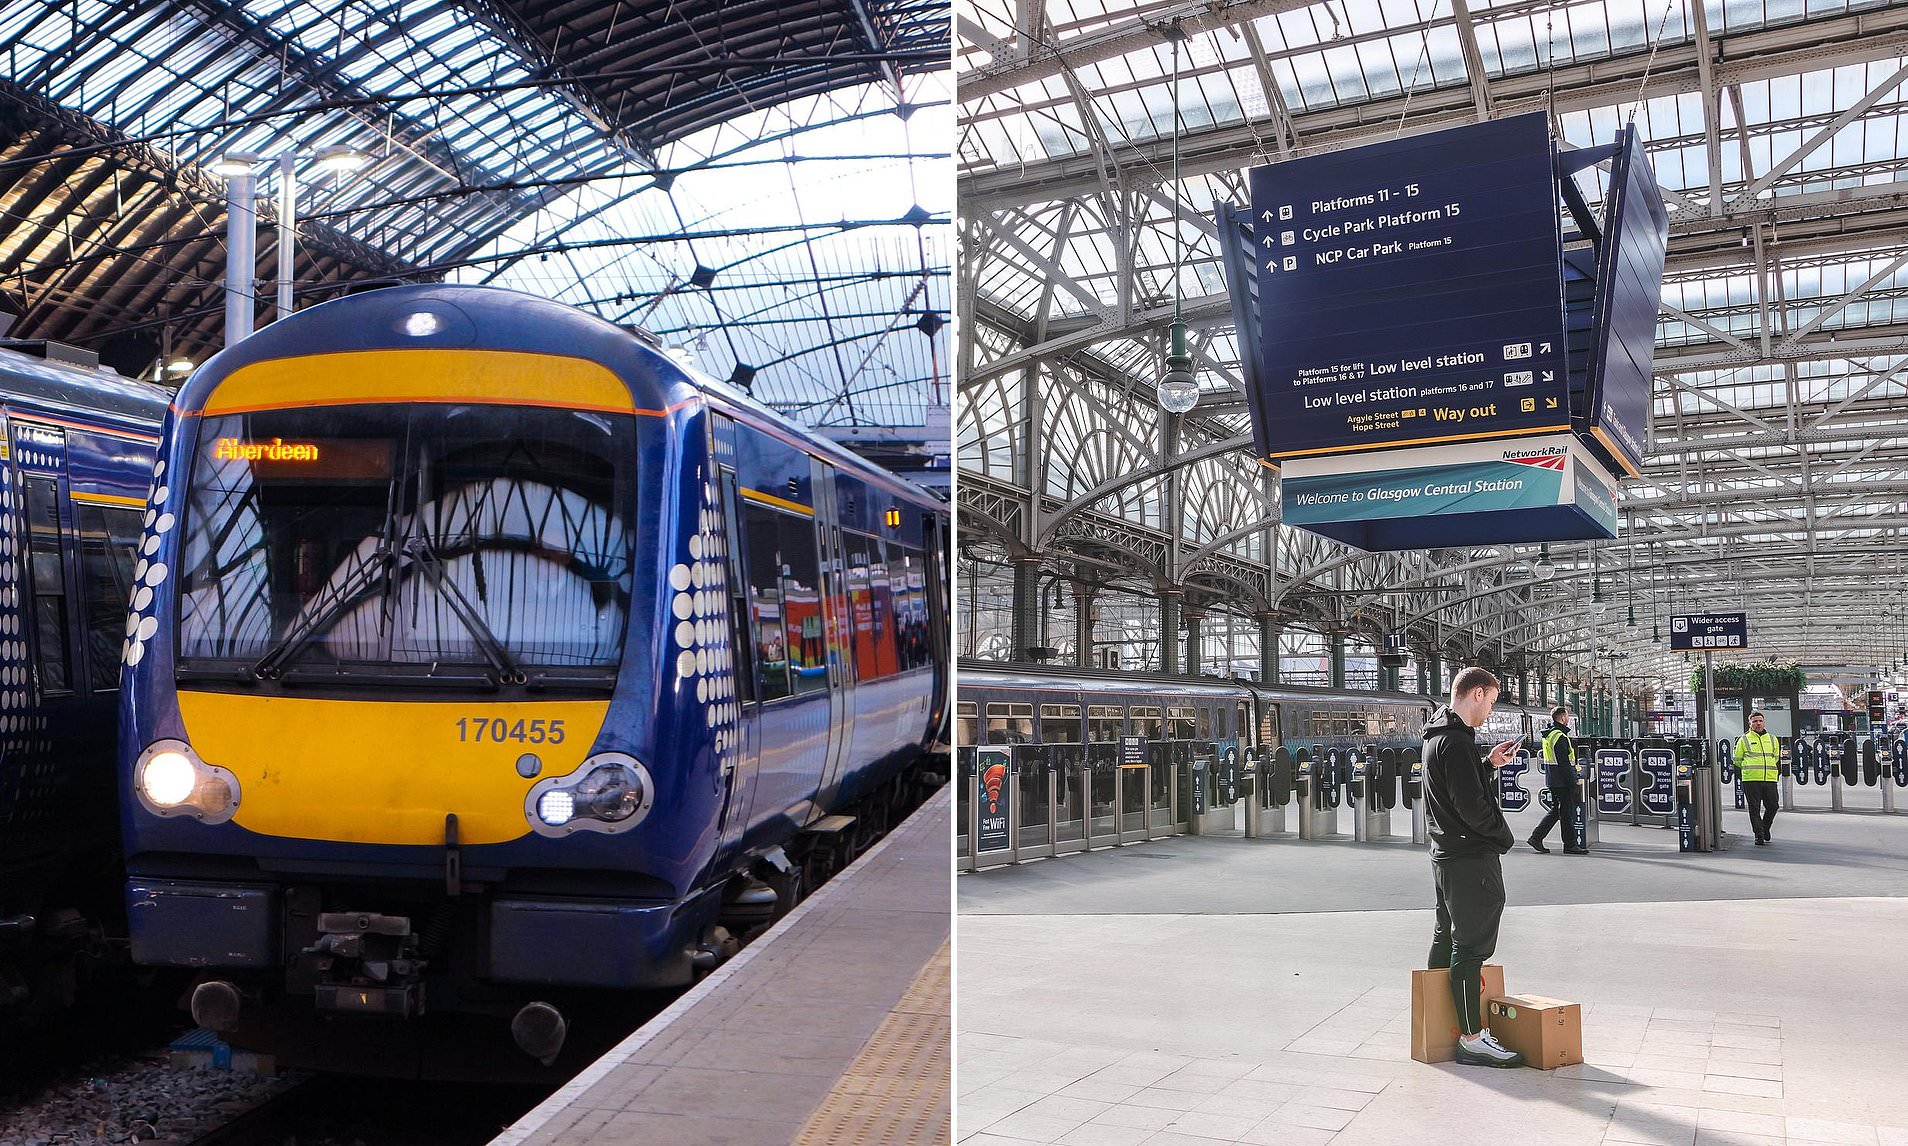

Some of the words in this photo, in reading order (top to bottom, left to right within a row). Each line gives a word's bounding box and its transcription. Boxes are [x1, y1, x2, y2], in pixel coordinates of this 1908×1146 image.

[1311, 194, 1375, 214] Platforms
[1377, 188, 1389, 202] 11
[1404, 183, 1420, 197] 15
[1302, 224, 1341, 242] Cycle
[1343, 218, 1375, 234] Park
[1378, 209, 1441, 229] Platform
[1444, 202, 1461, 217] 15
[1315, 249, 1343, 265] NCP
[1346, 247, 1370, 260] Car
[1373, 240, 1403, 256] Park
[1408, 239, 1442, 251] Platform
[1443, 236, 1452, 245] 15
[1298, 367, 1330, 377] Platform
[1330, 365, 1339, 373] 15
[1340, 364, 1352, 372] for
[1352, 362, 1365, 371] lift
[1370, 363, 1397, 375] Low
[1401, 356, 1432, 372] level
[1436, 352, 1485, 368] station
[1302, 374, 1338, 385] Platforms
[1339, 373, 1347, 381] 16
[1348, 372, 1356, 380] &
[1356, 371, 1365, 379] 17
[1304, 395, 1332, 409] Low
[1335, 389, 1366, 405] level
[1369, 386, 1417, 401] station
[1420, 385, 1457, 398] platforms
[1458, 383, 1468, 392] 16
[1469, 381, 1484, 391] and
[1485, 380, 1494, 389] 17
[1347, 414, 1373, 424] Argyle
[1374, 411, 1399, 421] Street
[1433, 407, 1466, 422] Way
[1469, 403, 1497, 418] out
[1352, 423, 1374, 432] Hope
[1374, 420, 1400, 430] Street
[216, 437, 319, 460] Aberdeen
[1296, 492, 1349, 506] Welcome
[1352, 491, 1364, 502] to
[1367, 487, 1421, 502] Glasgow
[1424, 480, 1472, 497] Central
[1474, 478, 1523, 493] Station
[1691, 616, 1713, 625] Wider
[1714, 616, 1740, 624] access
[1706, 625, 1724, 634] gate
[1388, 634, 1401, 648] 11
[456, 717, 565, 745] 170455
[990, 817, 1006, 830] WiFi
